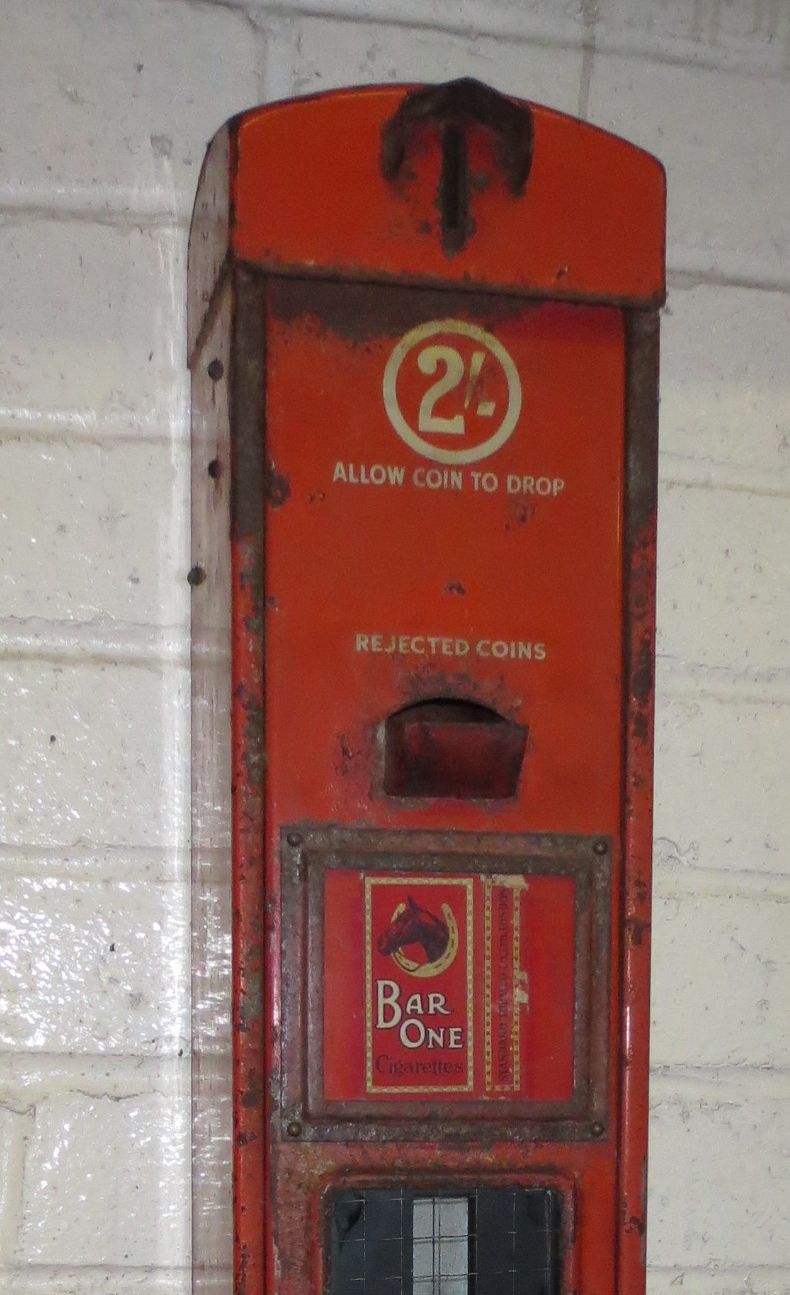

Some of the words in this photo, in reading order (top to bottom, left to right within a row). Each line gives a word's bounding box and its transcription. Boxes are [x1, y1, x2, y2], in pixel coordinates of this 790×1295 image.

[333, 461, 404, 485] ALLOW
[413, 468, 462, 490] COIN
[471, 471, 498, 493] TO
[507, 474, 565, 497] DROP
[355, 633, 470, 657] REJECTED
[476, 639, 547, 660] COINS
[375, 979, 453, 1030] BAR
[399, 1017, 465, 1050] ONE
[374, 1054, 465, 1078] Cigarettes
